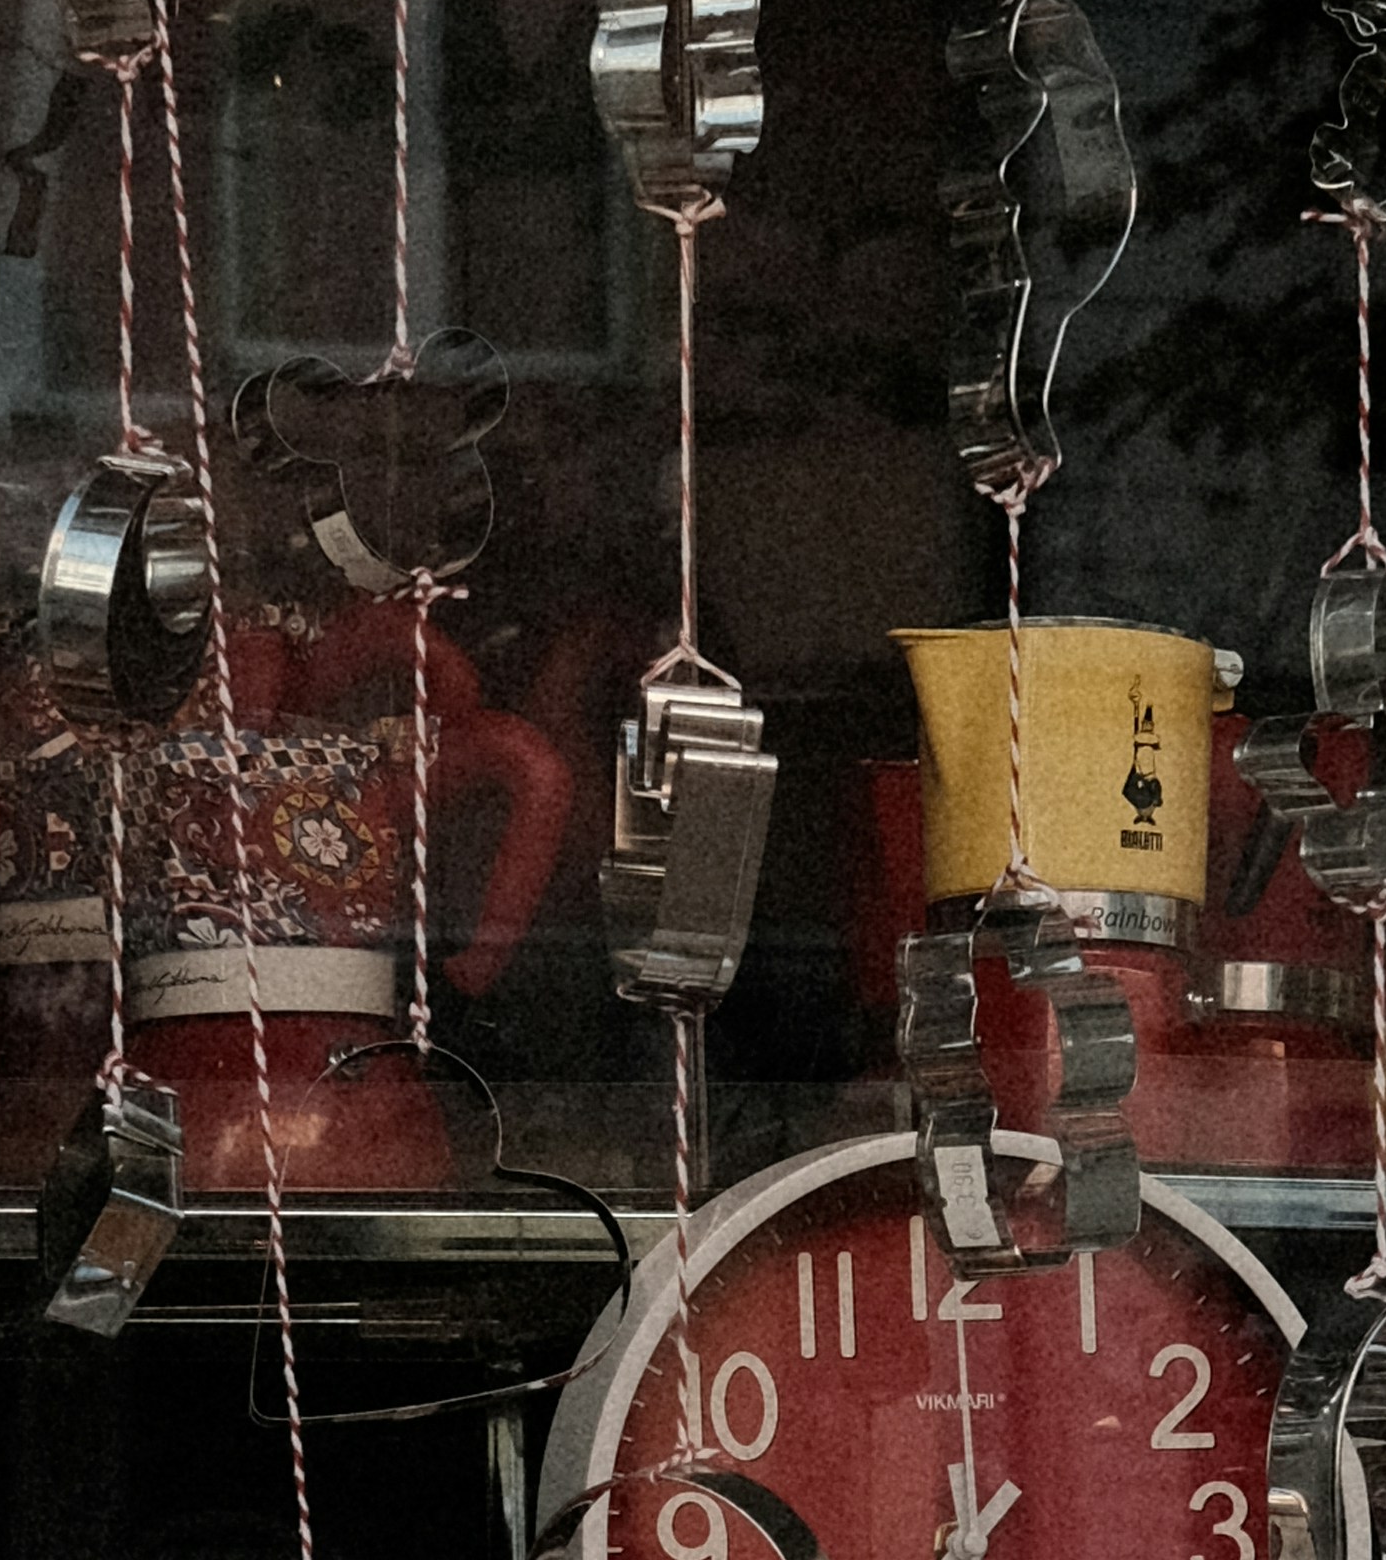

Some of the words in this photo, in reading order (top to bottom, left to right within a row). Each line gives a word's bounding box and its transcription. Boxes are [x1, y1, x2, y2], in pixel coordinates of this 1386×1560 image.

[798, 1252, 856, 1358] 11
[1078, 1250, 1097, 1354] 1
[686, 1351, 779, 1461] 10
[915, 1392, 995, 1411] VIKMARI
[1149, 1344, 1215, 1450] 2
